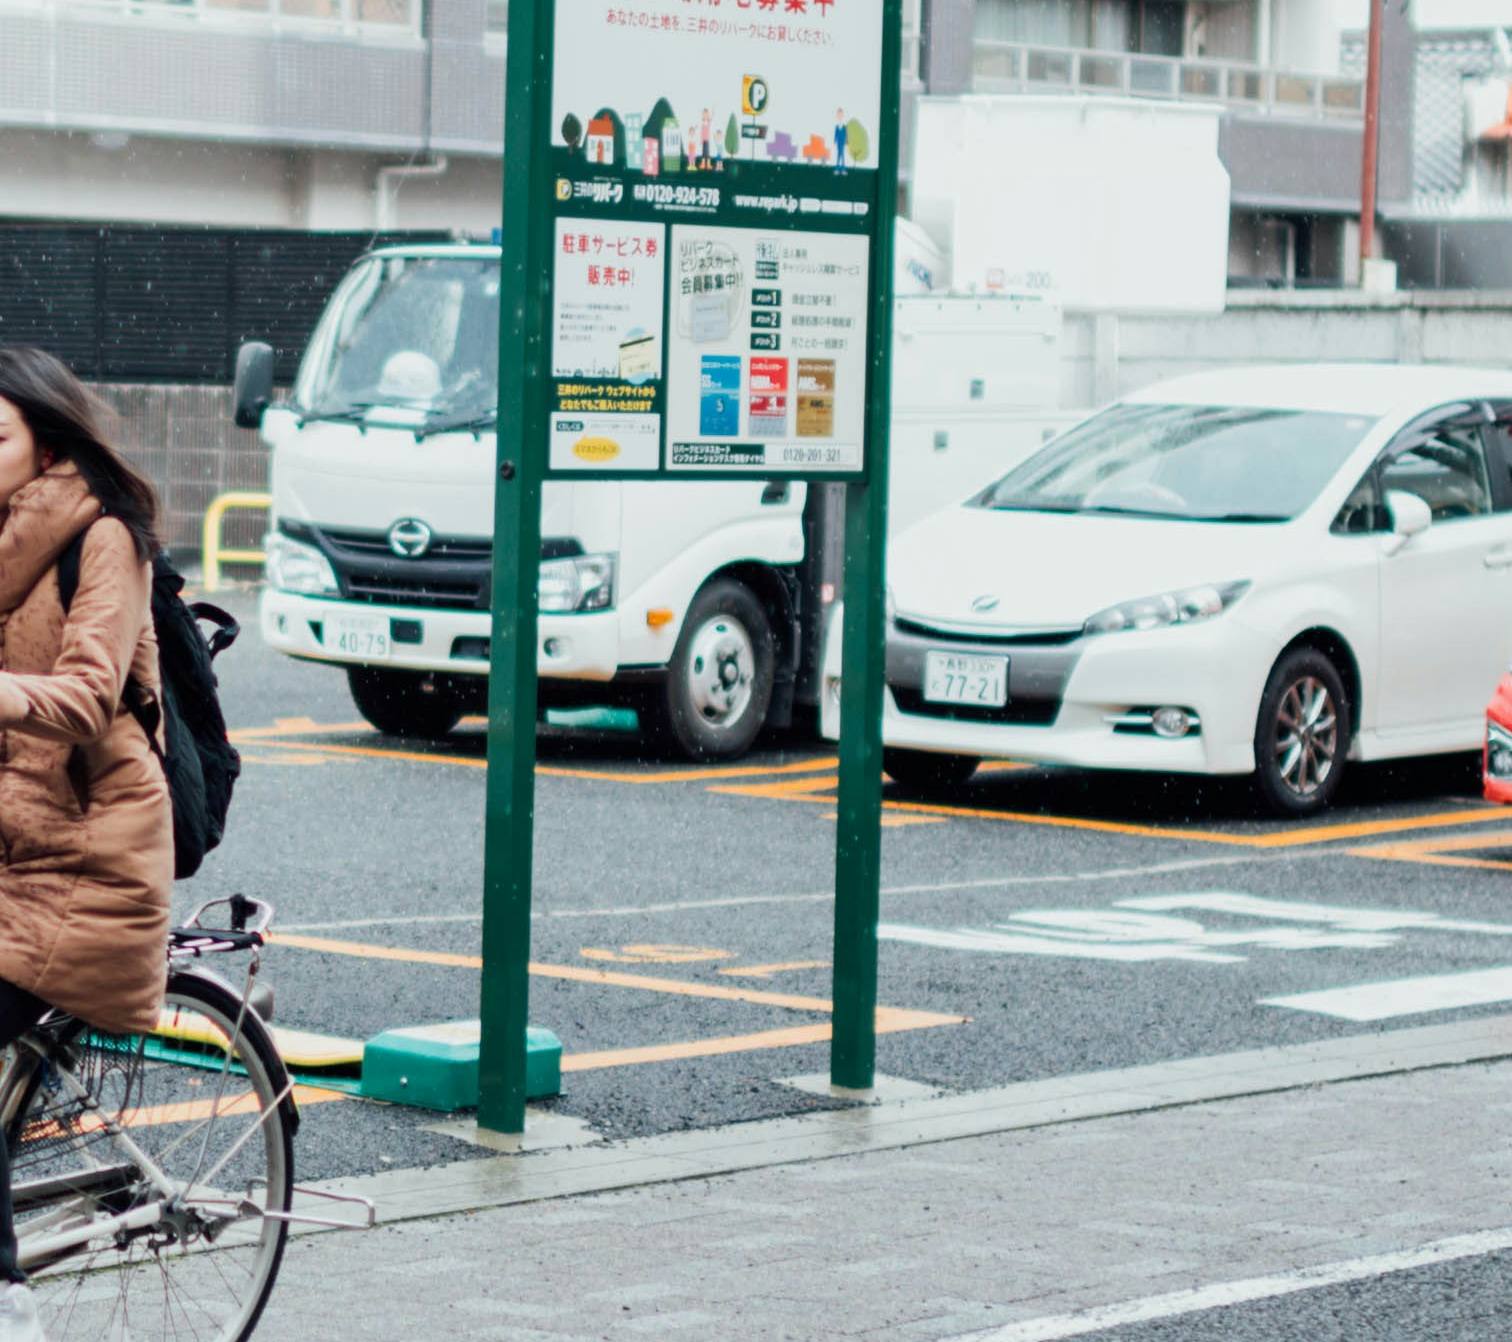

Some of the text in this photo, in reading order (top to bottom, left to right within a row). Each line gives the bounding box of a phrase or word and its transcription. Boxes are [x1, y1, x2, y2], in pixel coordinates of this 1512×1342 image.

[562, 233, 658, 258] 駐車サービス券
